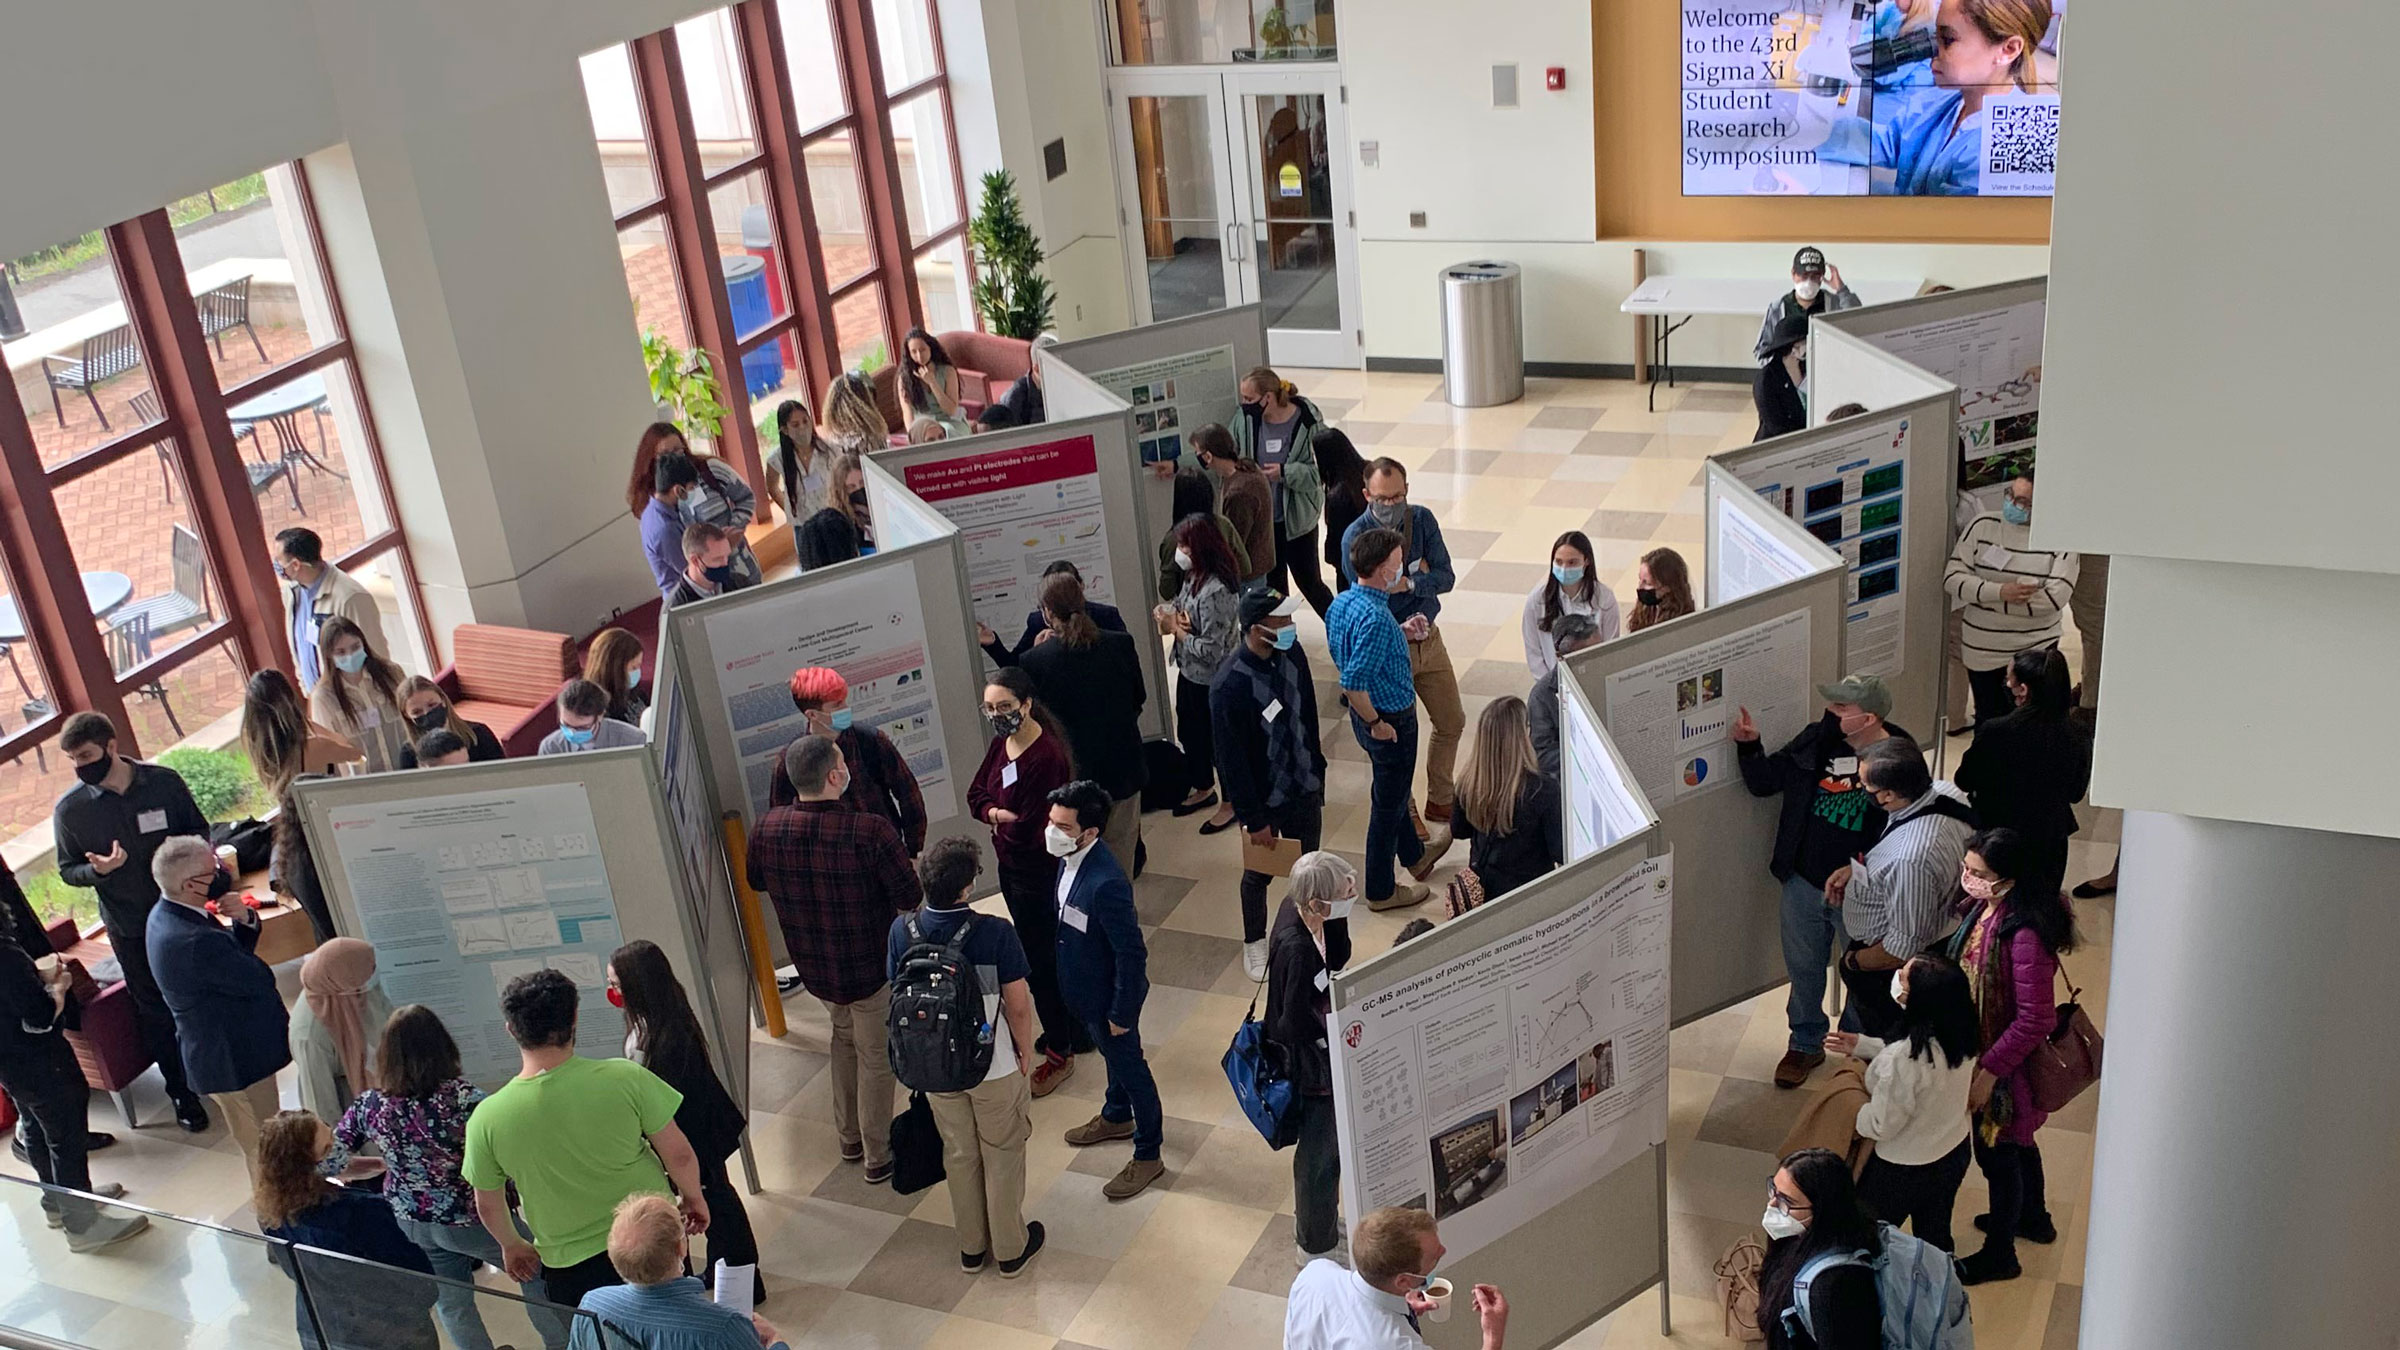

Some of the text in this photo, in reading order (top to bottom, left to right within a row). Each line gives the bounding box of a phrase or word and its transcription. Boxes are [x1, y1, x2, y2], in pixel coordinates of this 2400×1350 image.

[1685, 8, 1780, 28] Welcome
[1686, 33, 1797, 55] to the 43rd
[1686, 60, 1785, 87] Sigma Xi
[1686, 89, 1773, 110] Student
[1686, 117, 1787, 138] Research
[1686, 145, 1817, 170] Symposium
[1991, 183, 2008, 191] View
[2010, 183, 2021, 191] the
[913, 451, 1060, 480] We make Au and Pt electrodes that can be
[916, 483, 940, 494] turned
[952, 480, 967, 488] with
[967, 476, 989, 486] visible
[990, 472, 1007, 482] light
[1361, 991, 1394, 1012] GC-MS
[1395, 976, 1434, 998] analysis
[1435, 969, 1445, 980] of
[1447, 950, 1492, 977] polycyclic
[1494, 933, 1533, 955] aromatic
[1535, 904, 1590, 938] hydrocarbons
[1604, 869, 1640, 898] brownfield
[1641, 863, 1659, 875] soil
